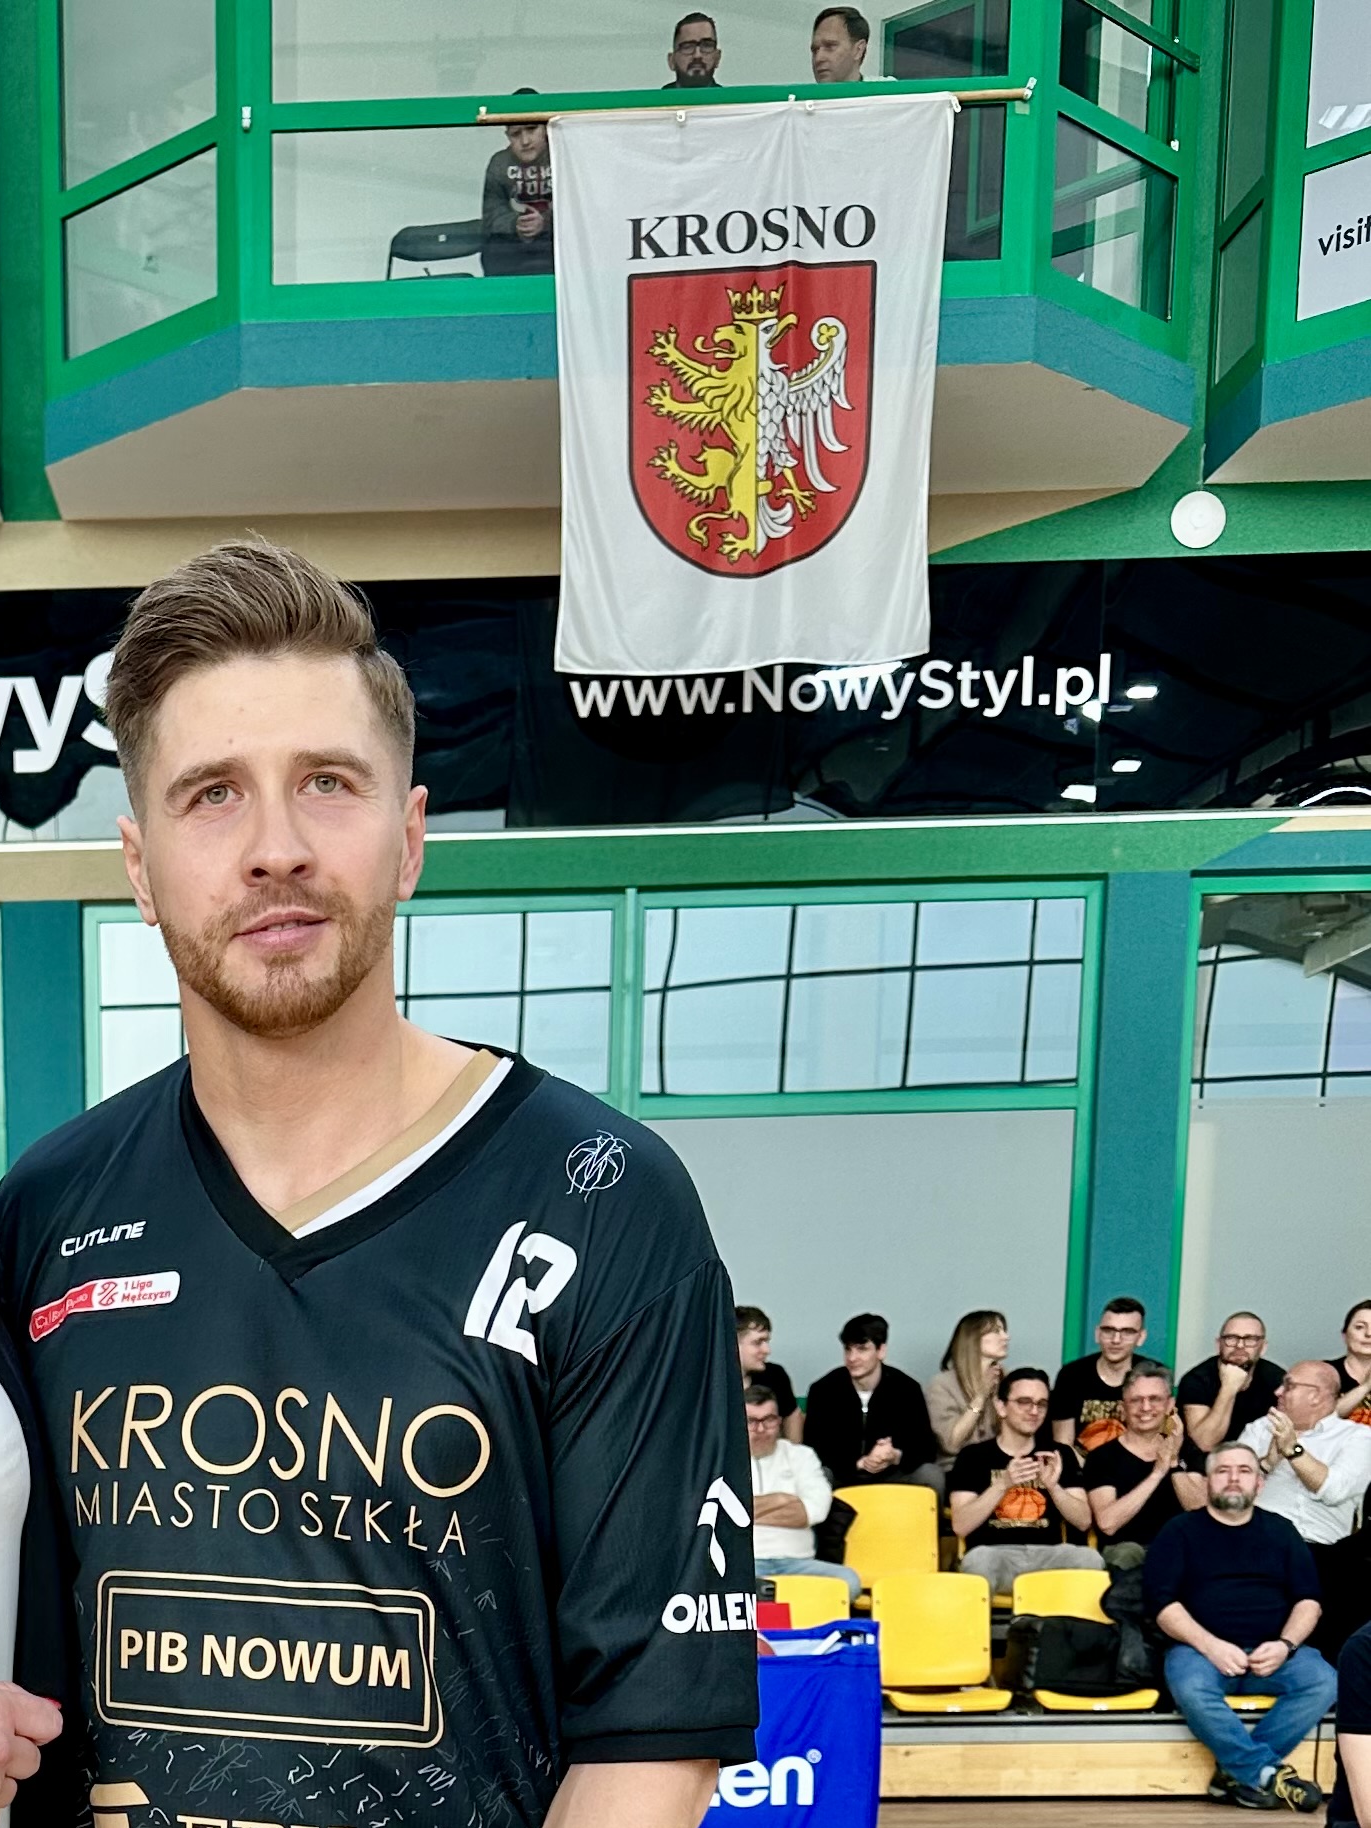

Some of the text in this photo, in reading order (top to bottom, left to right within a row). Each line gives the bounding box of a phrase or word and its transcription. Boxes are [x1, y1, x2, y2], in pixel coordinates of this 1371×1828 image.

[626, 204, 876, 261] KROSNO
[569, 653, 1112, 721] www.NowyStyl.pl
[60, 1220, 147, 1257] CUTLINE
[131, 1279, 154, 1292] Liga
[463, 1220, 578, 1366] 12
[70, 1384, 491, 1498] KROSNO
[75, 1481, 467, 1557] MIASTO SZKŁA
[661, 1592, 758, 1635] ORLEN
[120, 1628, 411, 1690] PIB NOWUM
